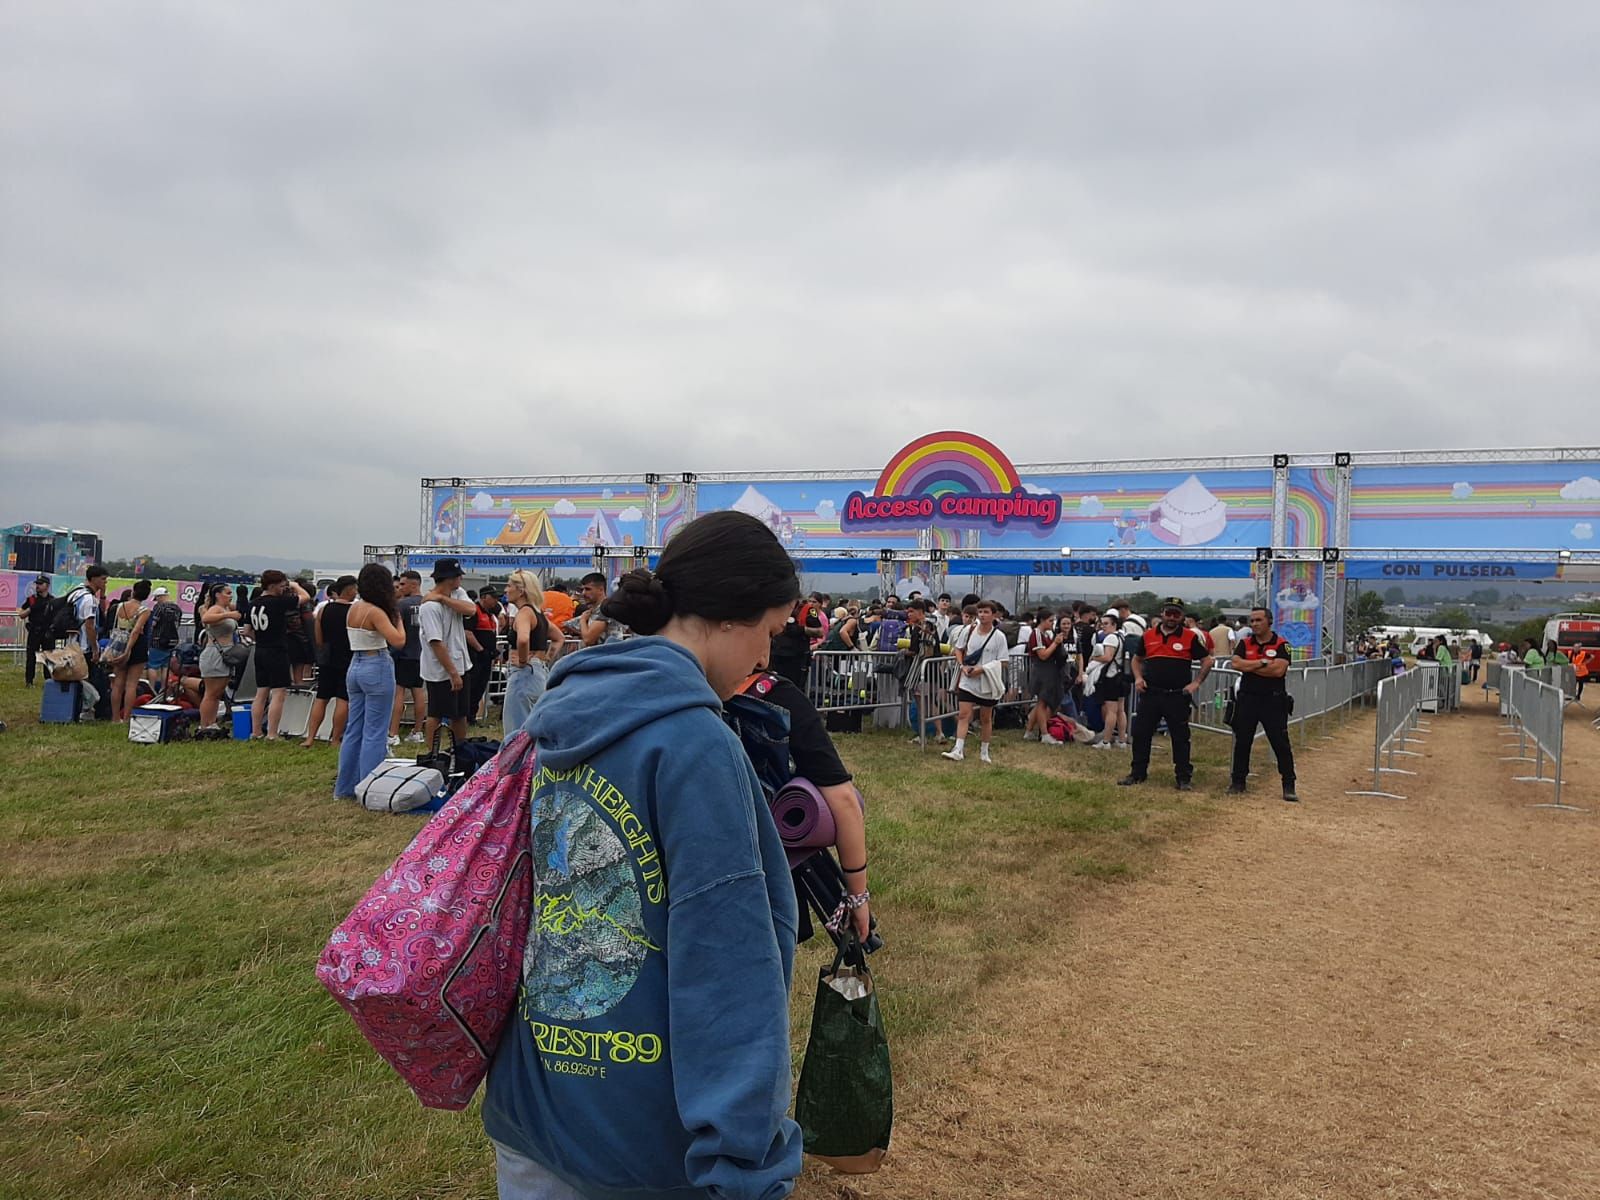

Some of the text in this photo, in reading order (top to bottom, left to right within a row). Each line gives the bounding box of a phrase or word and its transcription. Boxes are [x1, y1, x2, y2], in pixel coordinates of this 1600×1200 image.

[848, 492, 1057, 524] Acceso camping
[473, 557, 521, 565] FRONTSTAGE
[527, 557, 567, 565] PLATINUM
[1032, 560, 1152, 574] SIN PULSERA
[1381, 563, 1516, 577] CON PULSERA
[250, 605, 269, 631] 66
[581, 766, 666, 904] HEIGHTS
[600, 1066, 607, 1079] E
